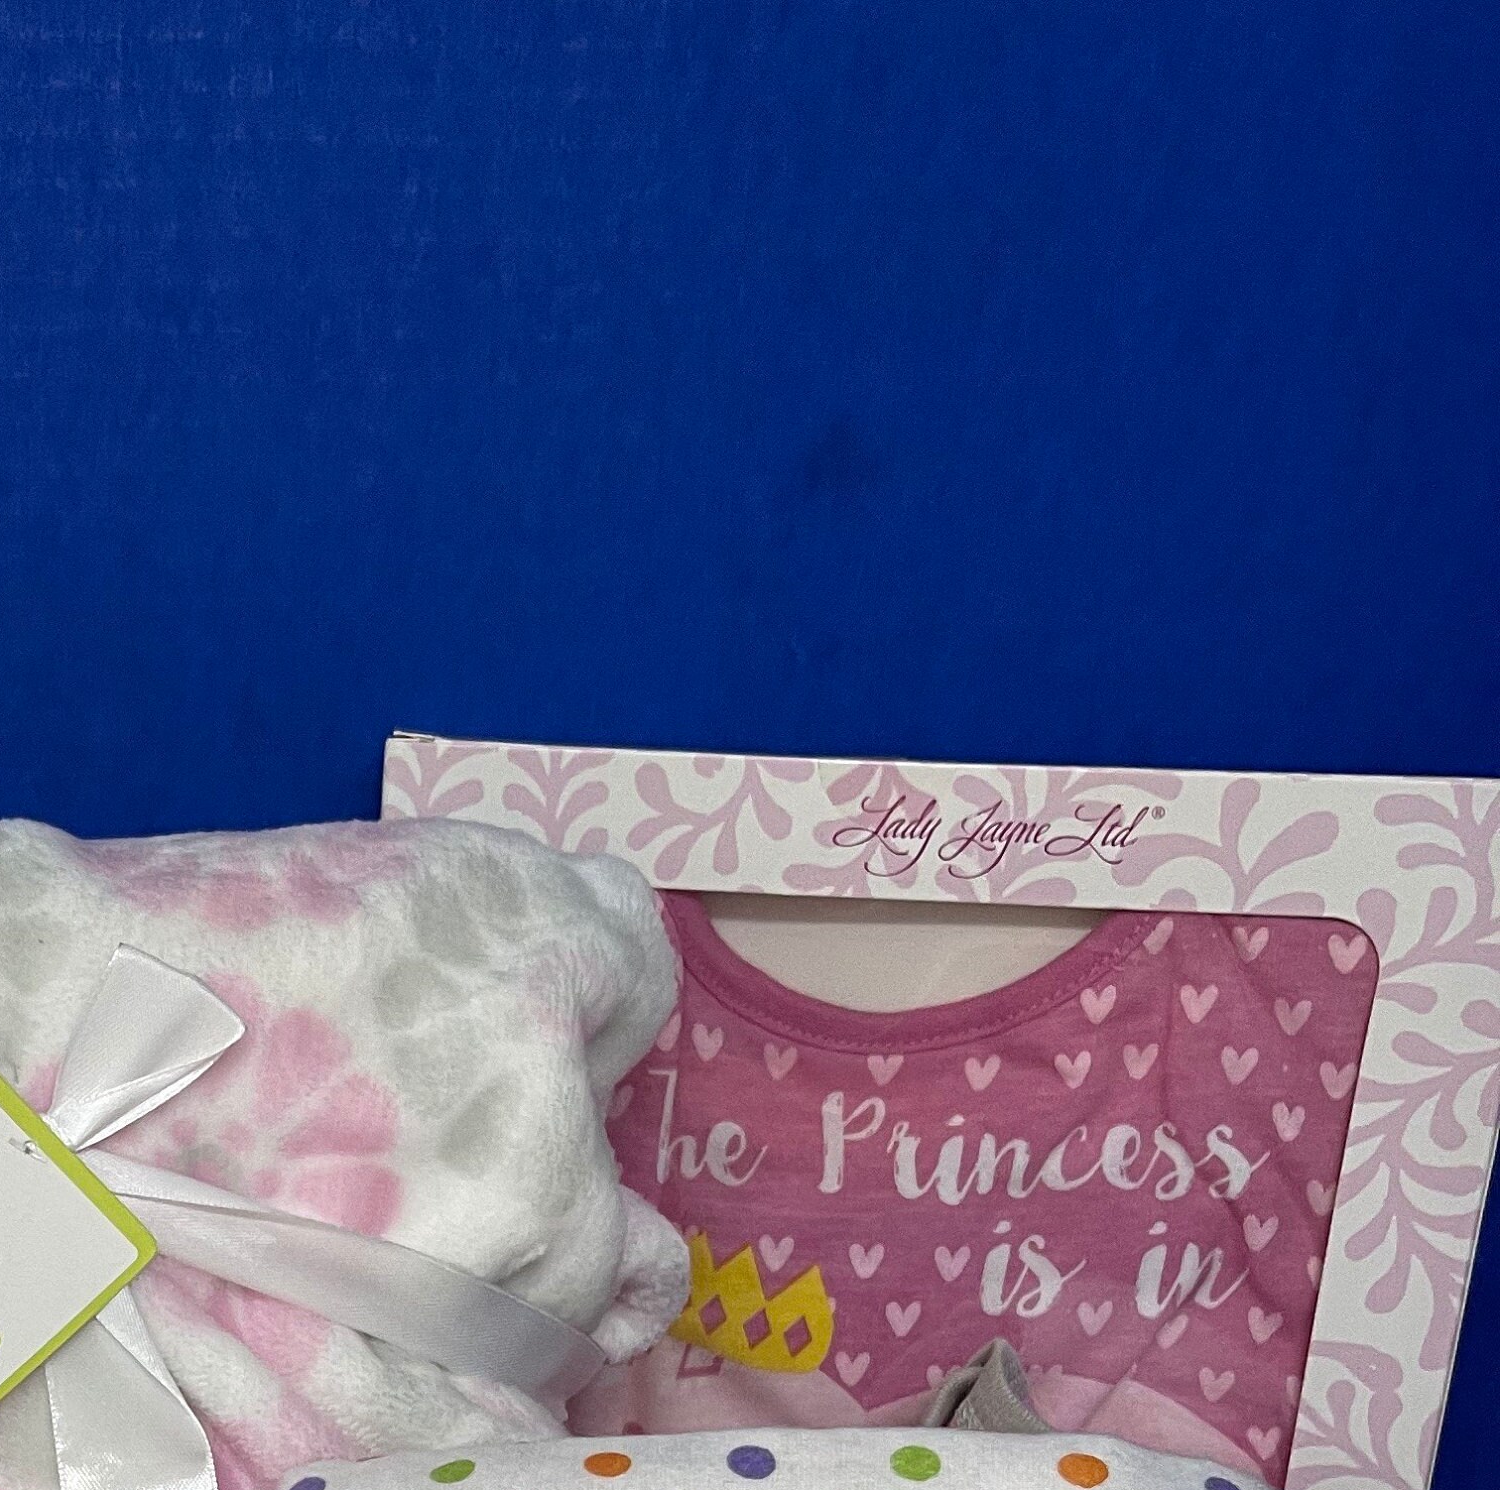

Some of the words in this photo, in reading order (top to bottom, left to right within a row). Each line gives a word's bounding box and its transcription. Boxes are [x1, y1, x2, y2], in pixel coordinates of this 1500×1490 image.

[832, 794, 941, 877] Lady
[937, 799, 1051, 879] Jayne
[817, 1089, 1270, 1206] Princess
[978, 1220, 1087, 1319] is
[1134, 1220, 1252, 1320] in
